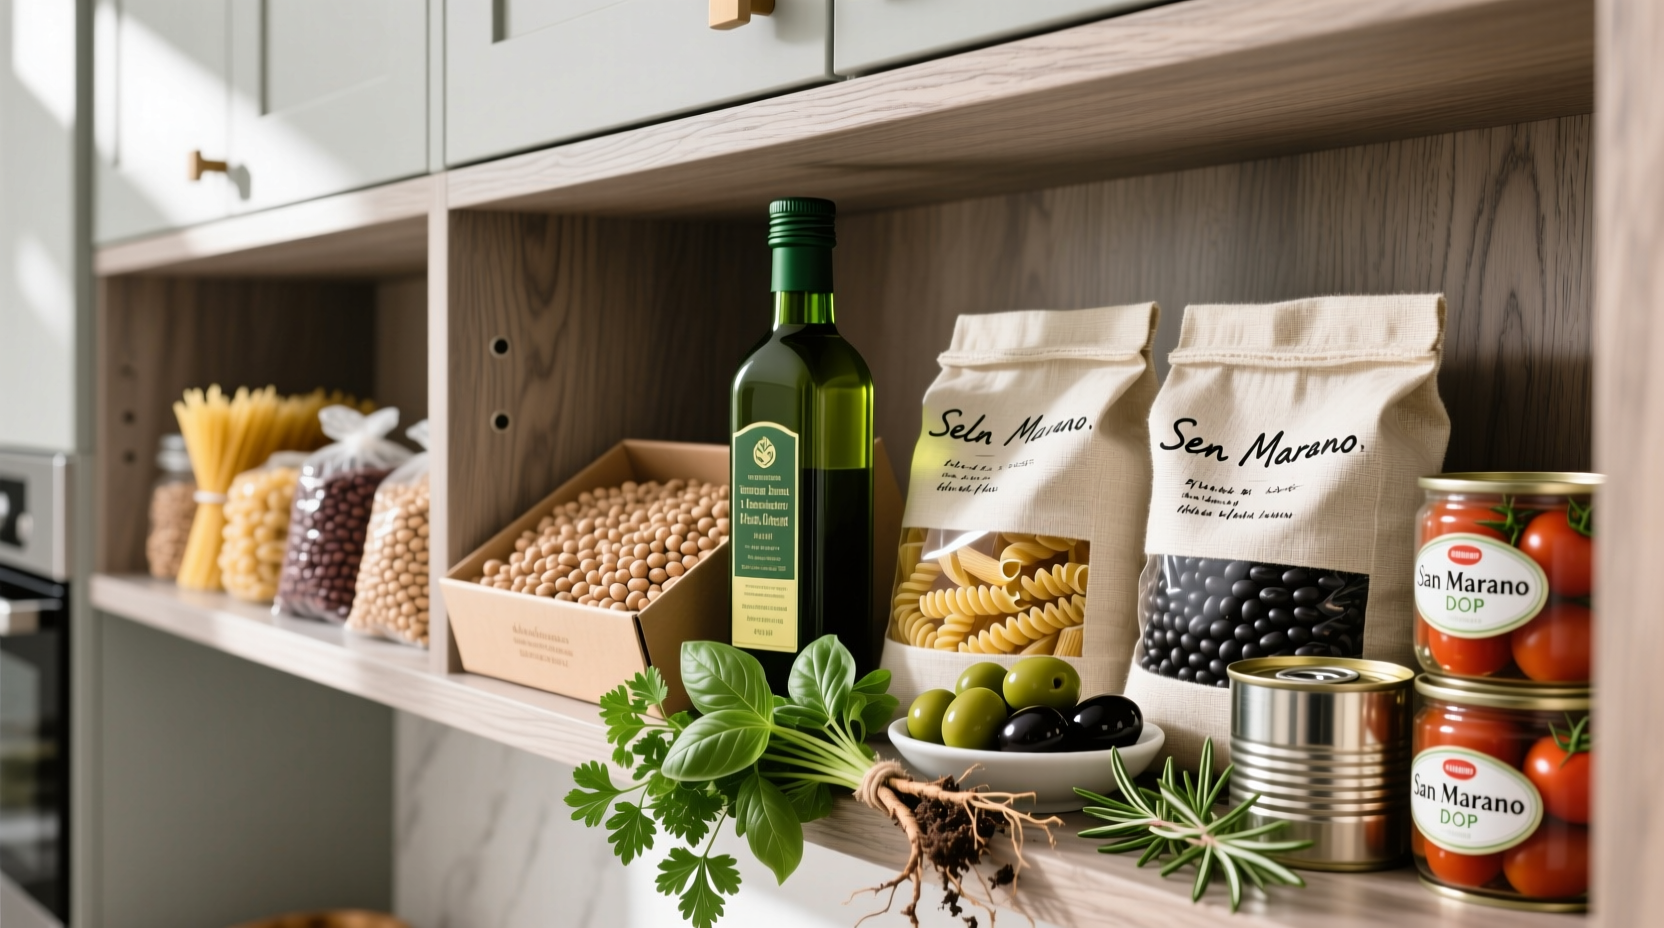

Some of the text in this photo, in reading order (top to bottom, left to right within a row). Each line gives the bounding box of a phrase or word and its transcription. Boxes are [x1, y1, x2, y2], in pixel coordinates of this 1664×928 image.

[1159, 417, 1229, 462] Sen
[1417, 564, 1529, 596] San Marano
[1446, 595, 1485, 613] DOP
[1414, 772, 1525, 815] San Marano
[1440, 808, 1478, 828] DOP
